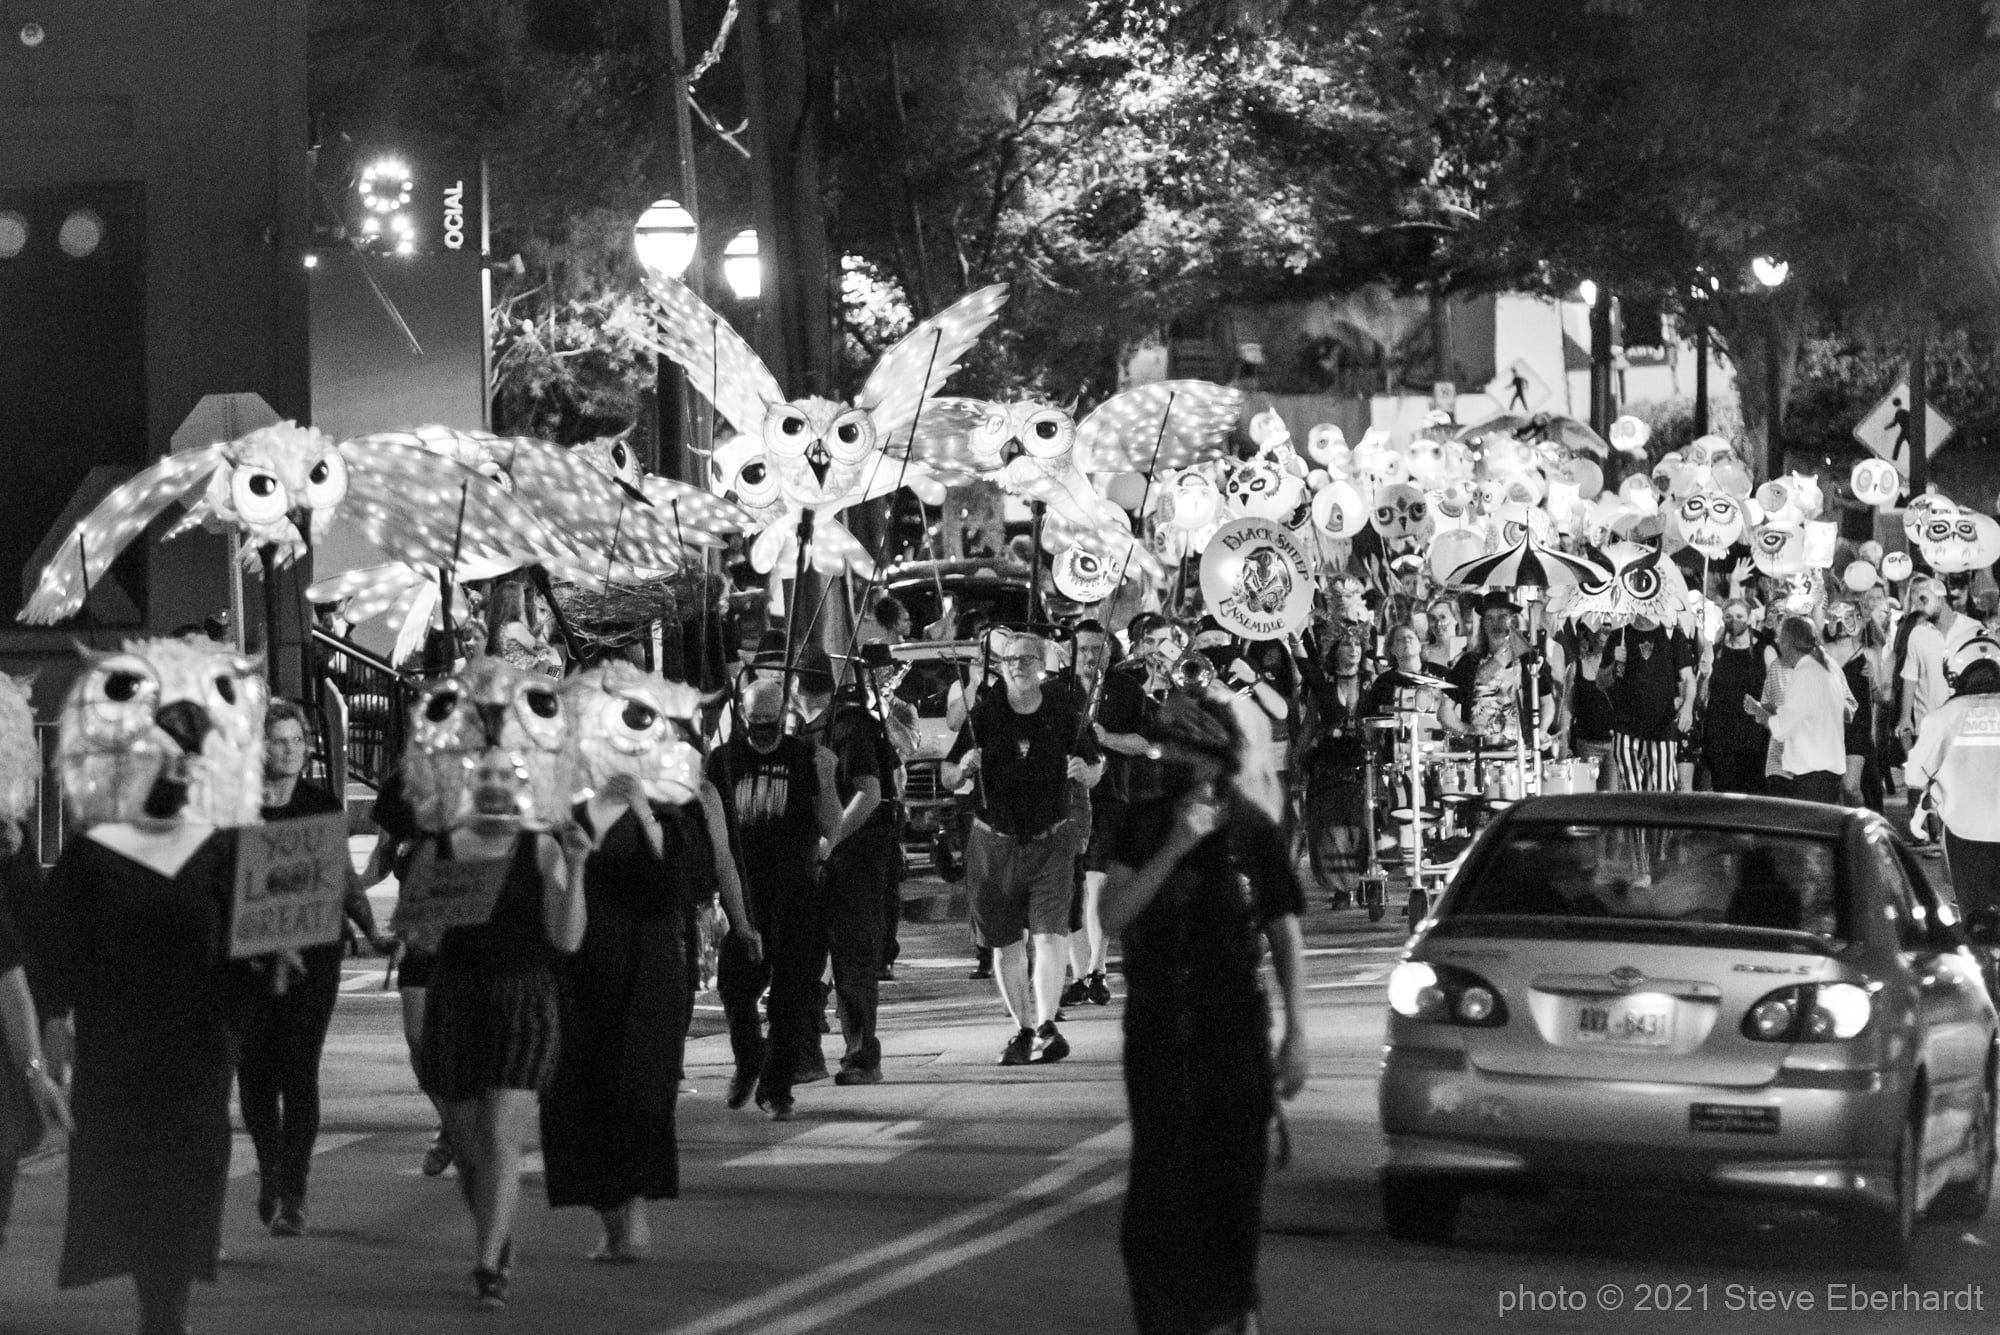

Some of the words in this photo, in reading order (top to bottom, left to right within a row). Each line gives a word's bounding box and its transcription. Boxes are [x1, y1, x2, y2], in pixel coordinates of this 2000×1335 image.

[1222, 527, 1275, 551] BLACK
[1276, 533, 1310, 582] SHEEP
[1219, 597, 1286, 634] ENSEMBLE
[259, 823, 327, 862] YOU
[243, 857, 337, 903] LOOK
